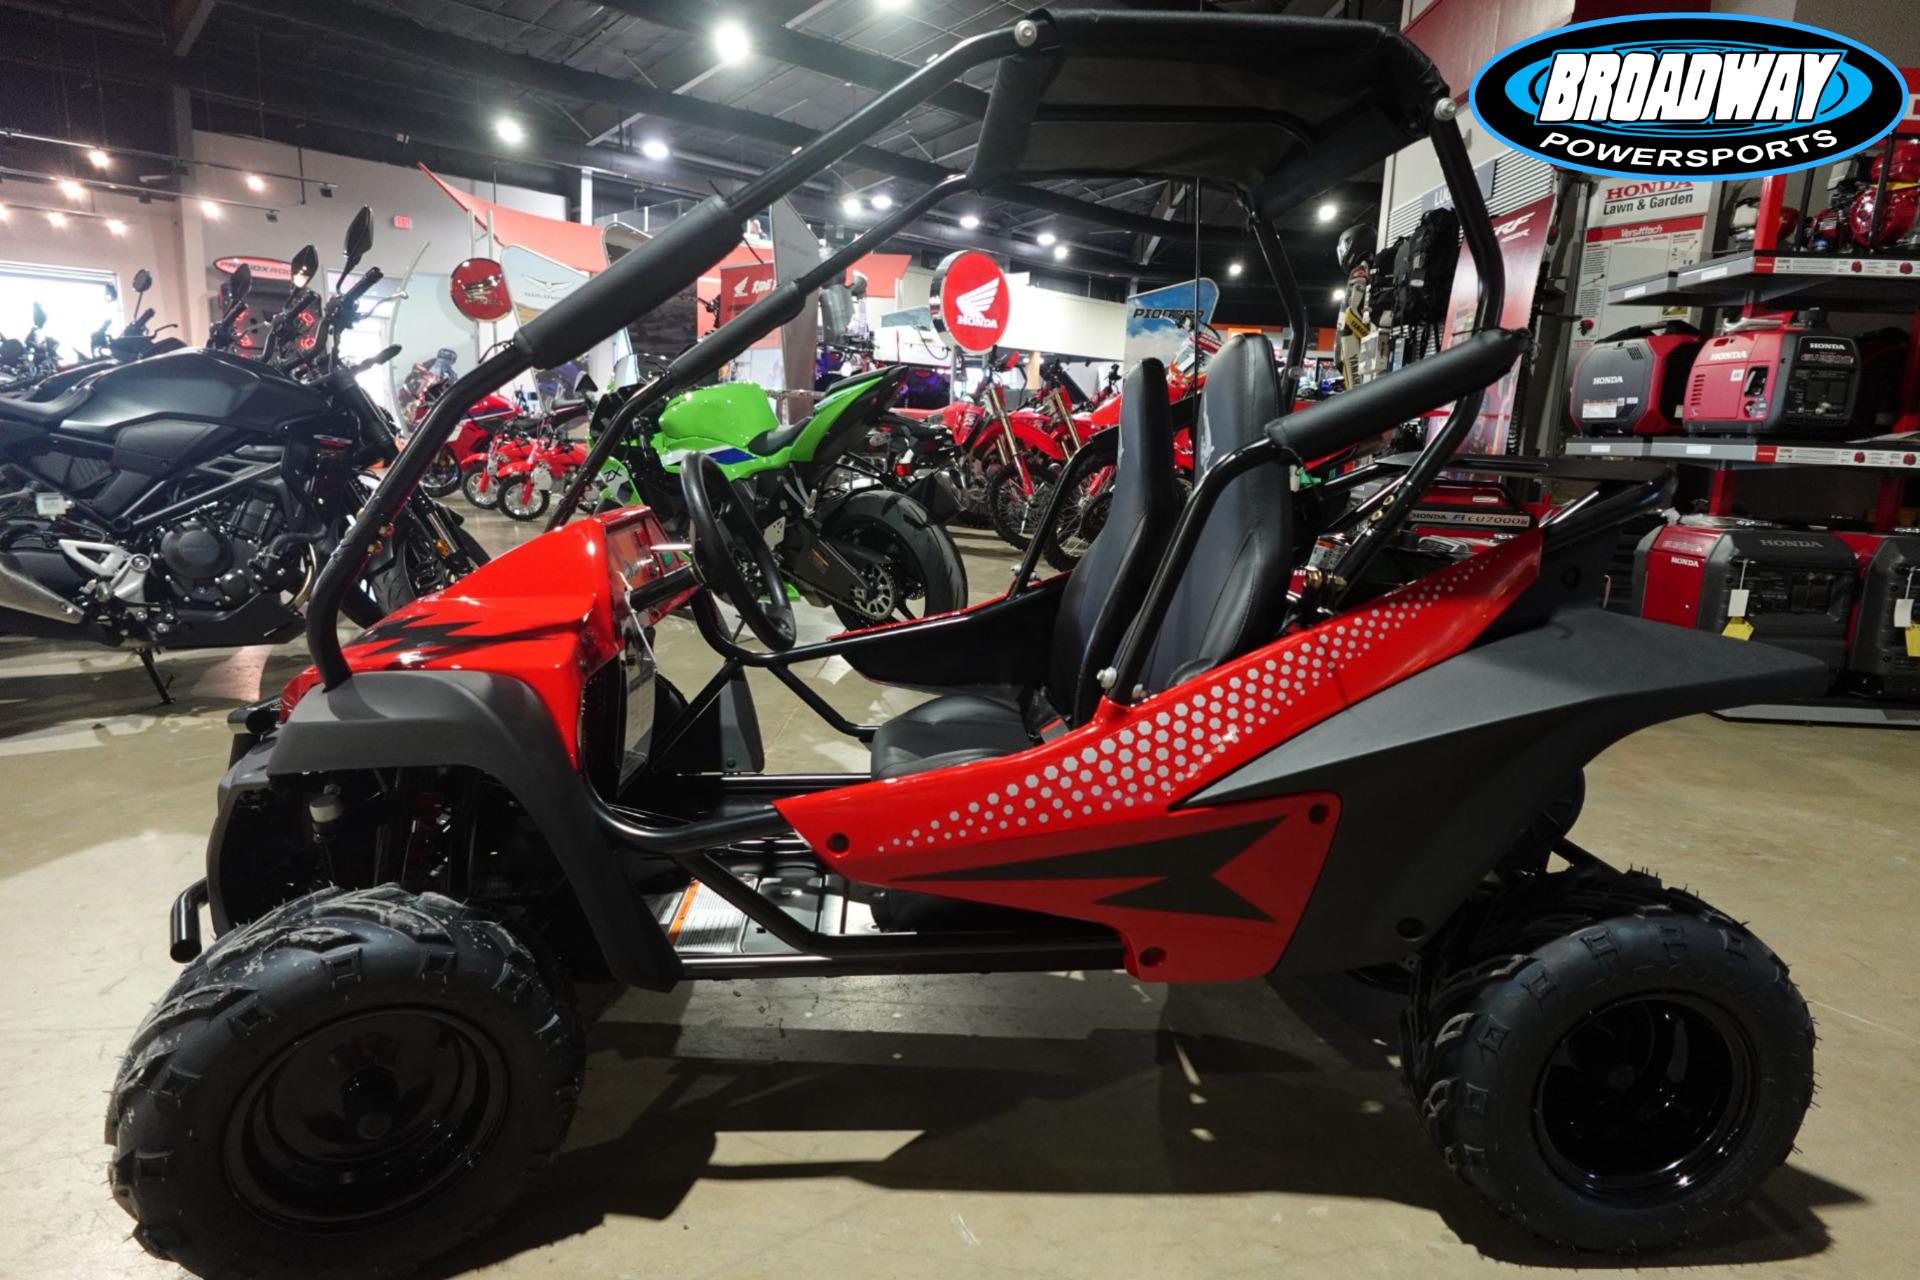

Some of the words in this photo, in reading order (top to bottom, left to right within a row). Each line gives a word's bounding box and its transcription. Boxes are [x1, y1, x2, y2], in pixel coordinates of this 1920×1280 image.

[1605, 181, 1694, 200] HONDA
[1603, 203, 1634, 215] Lawn
[1636, 199, 1645, 211] &
[1650, 193, 1693, 209] Garden
[1133, 308, 1205, 319] PIONR
[956, 315, 999, 329] HONDA
[1810, 342, 1846, 350] HONDA
[1709, 350, 1748, 361] HONDA
[1593, 375, 1624, 385] HONDA
[1412, 512, 1447, 520] HONDA
[1760, 539, 1823, 548] HONDA
[1671, 556, 1699, 568] HONDA
